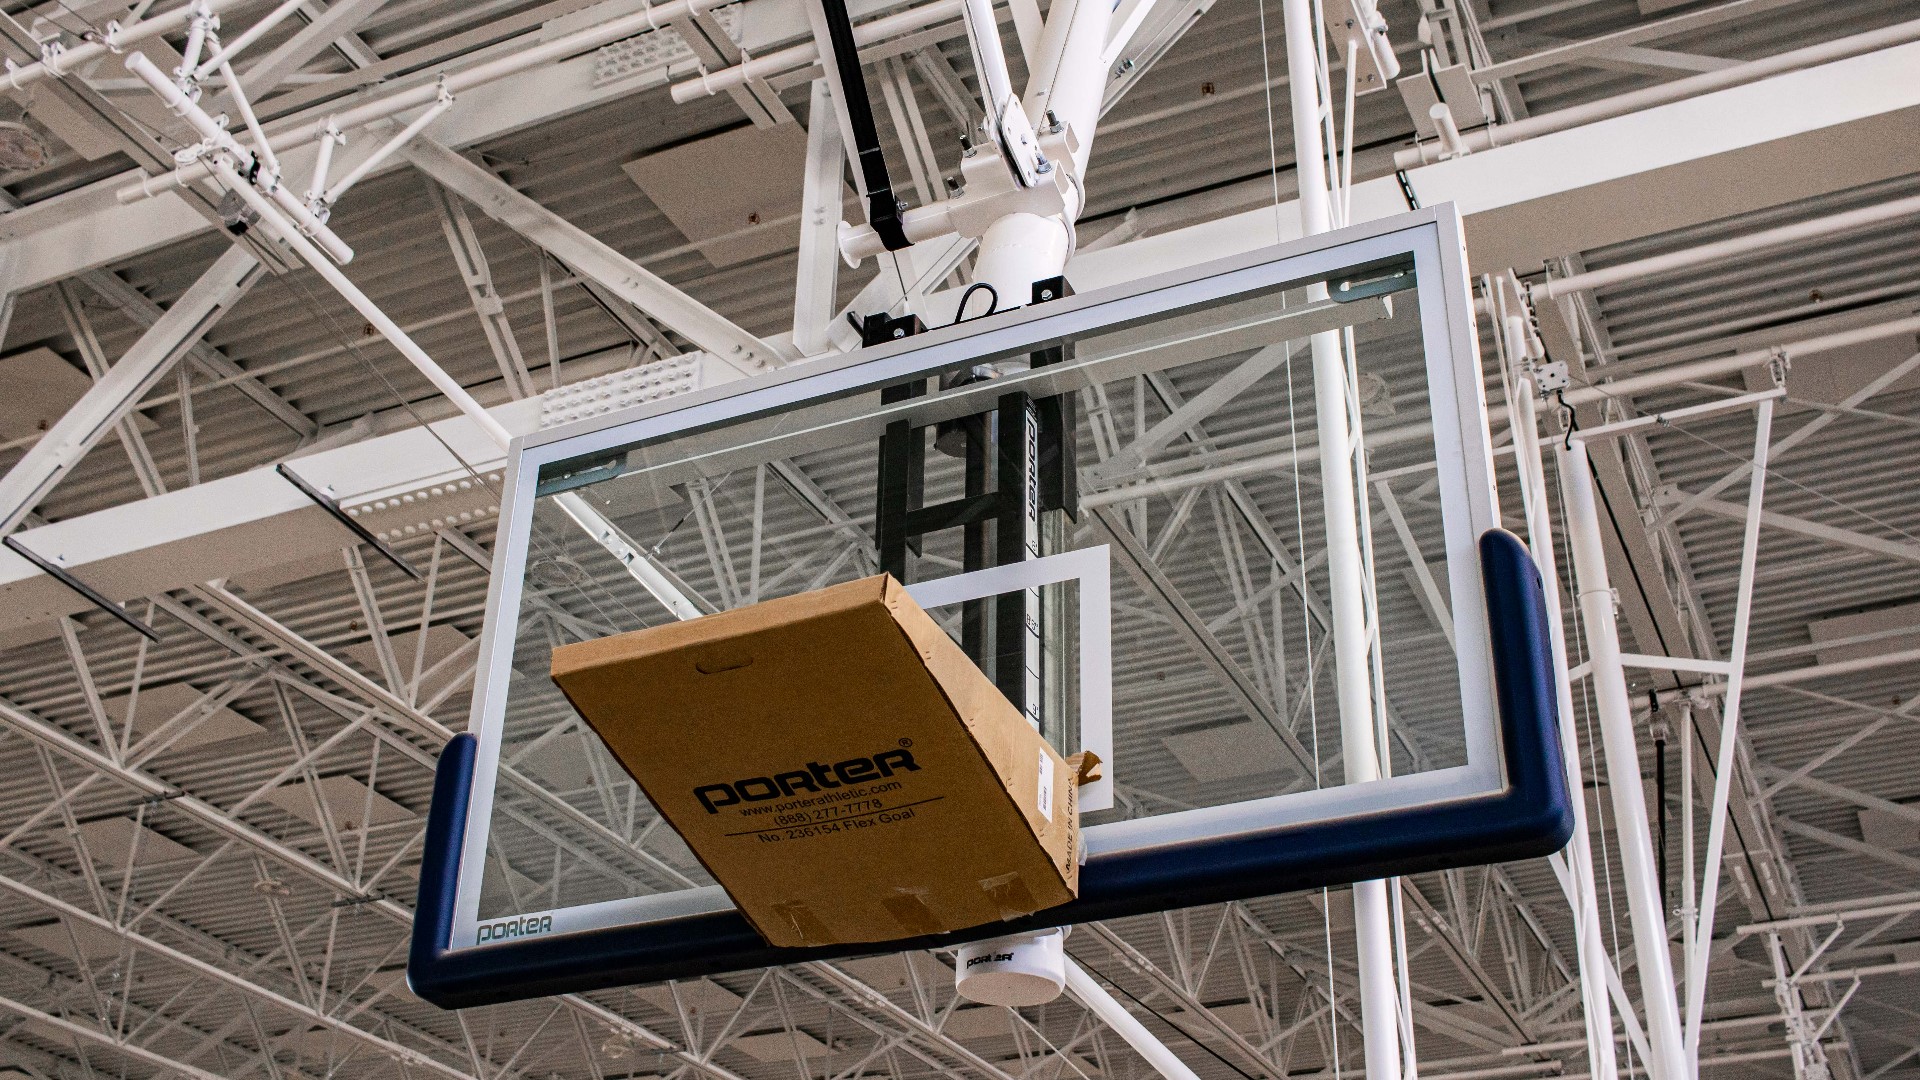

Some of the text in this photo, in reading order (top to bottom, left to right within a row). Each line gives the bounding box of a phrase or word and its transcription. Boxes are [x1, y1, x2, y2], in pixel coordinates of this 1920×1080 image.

[739, 781, 903, 817] www.porterathletic.com
[773, 798, 883, 828] (888) 277-7778
[757, 807, 916, 843] No. 236154 Flex Goal
[1067, 817, 1073, 832] IN
[1065, 833, 1073, 872] MADE
